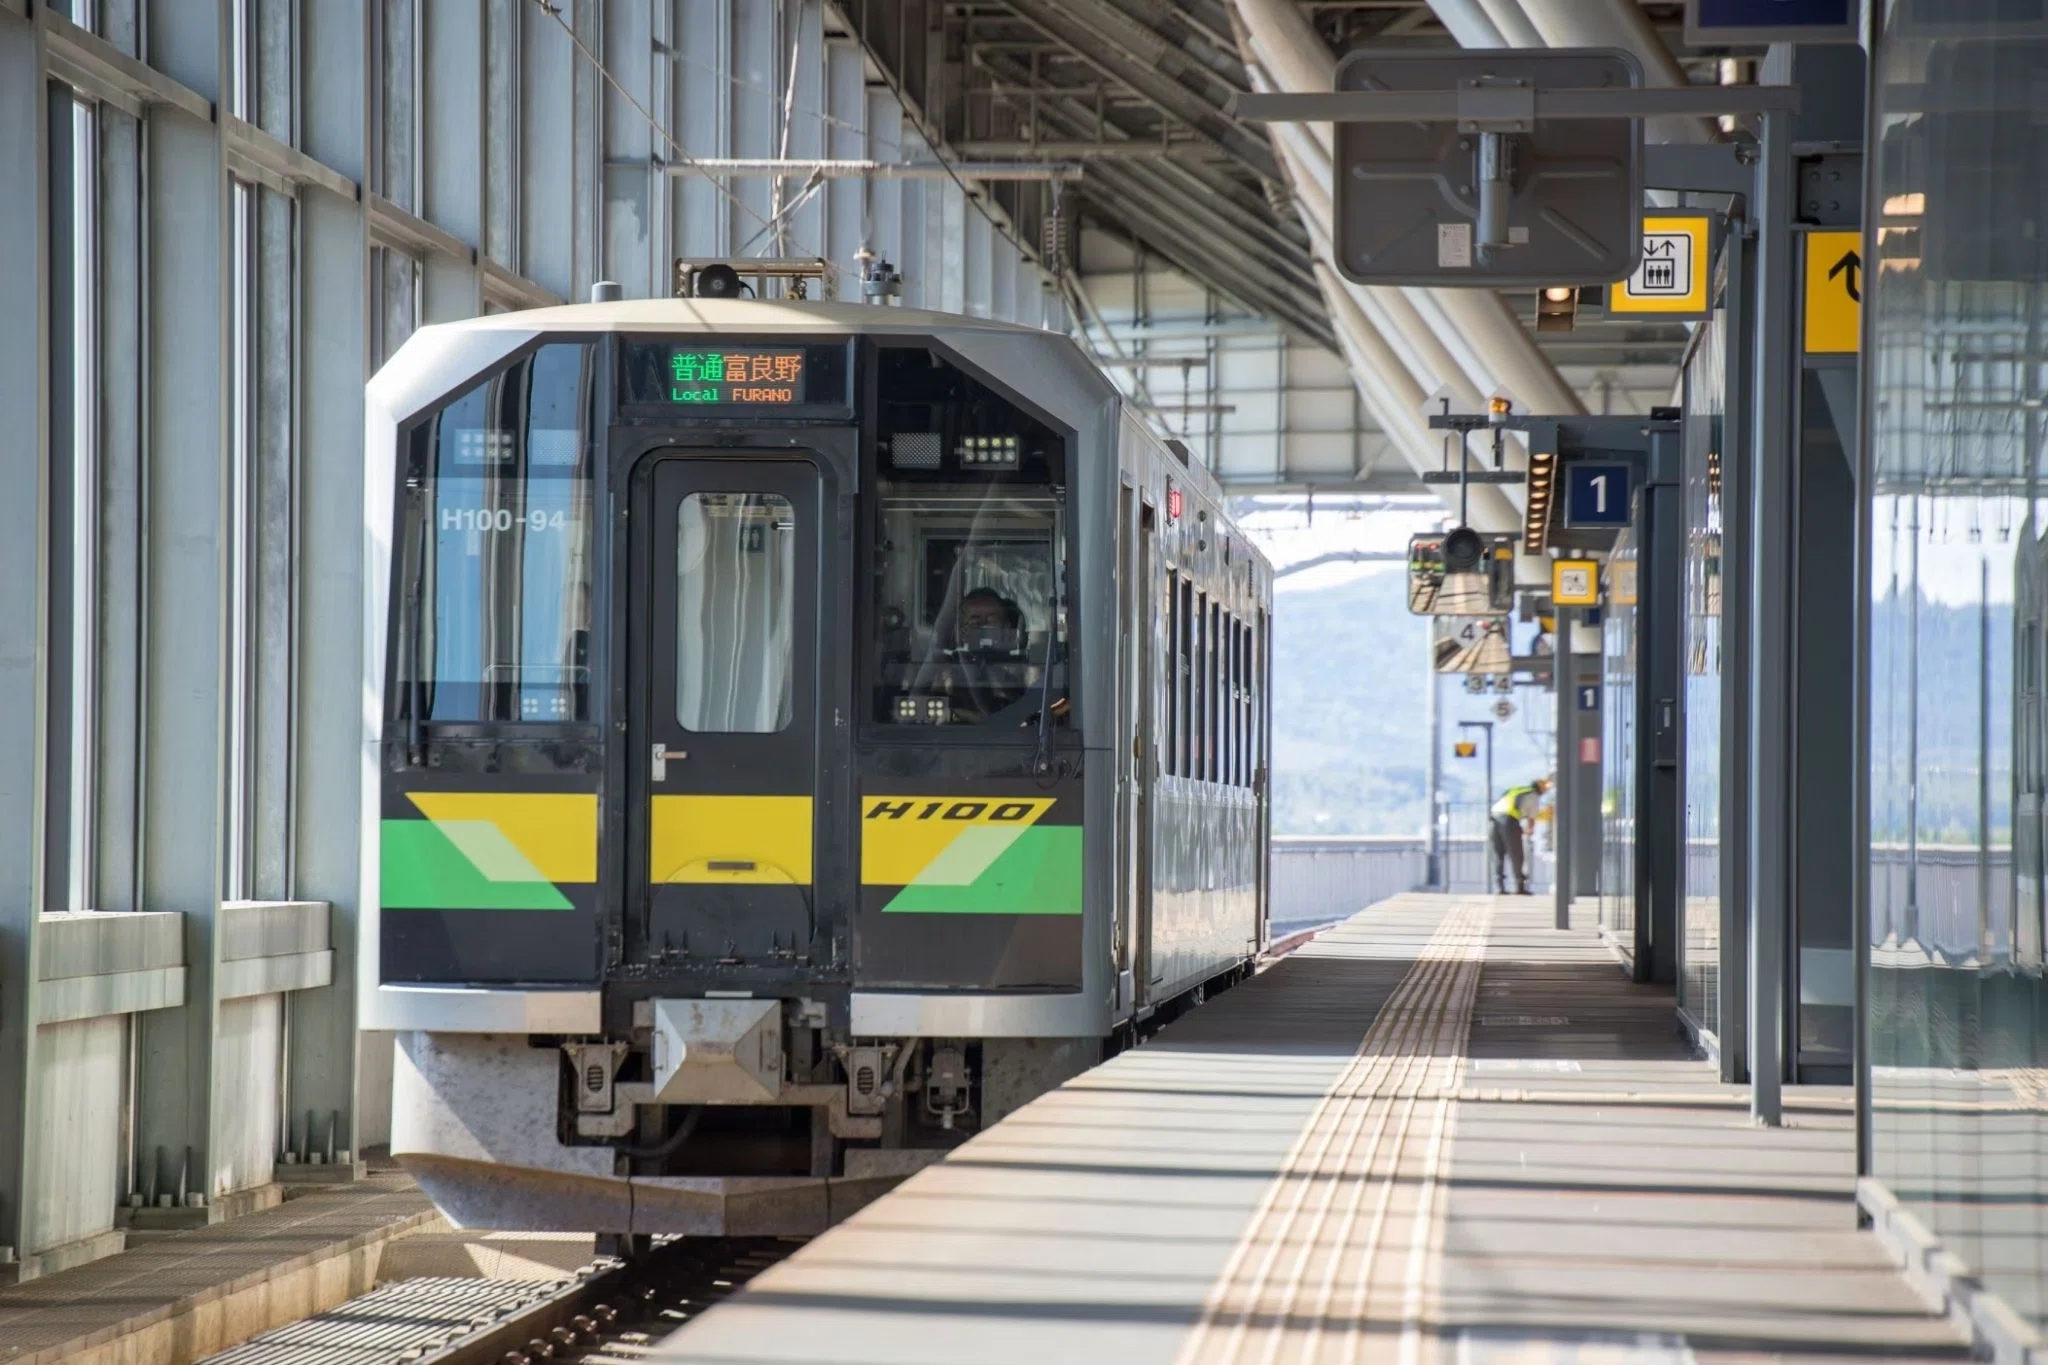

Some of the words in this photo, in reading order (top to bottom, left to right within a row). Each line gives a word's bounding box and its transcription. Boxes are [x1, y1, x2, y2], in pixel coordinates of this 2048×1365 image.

[672, 388, 719, 401] Local
[732, 388, 792, 402] FURANO
[1589, 474, 1609, 513] 1
[441, 508, 566, 532] H100-94
[1460, 624, 1475, 640] 4
[1470, 677, 1482, 691] 3
[1497, 677, 1509, 690] 4
[1583, 687, 1595, 708] 1
[1497, 702, 1510, 717] 5
[865, 801, 1036, 821] H100
